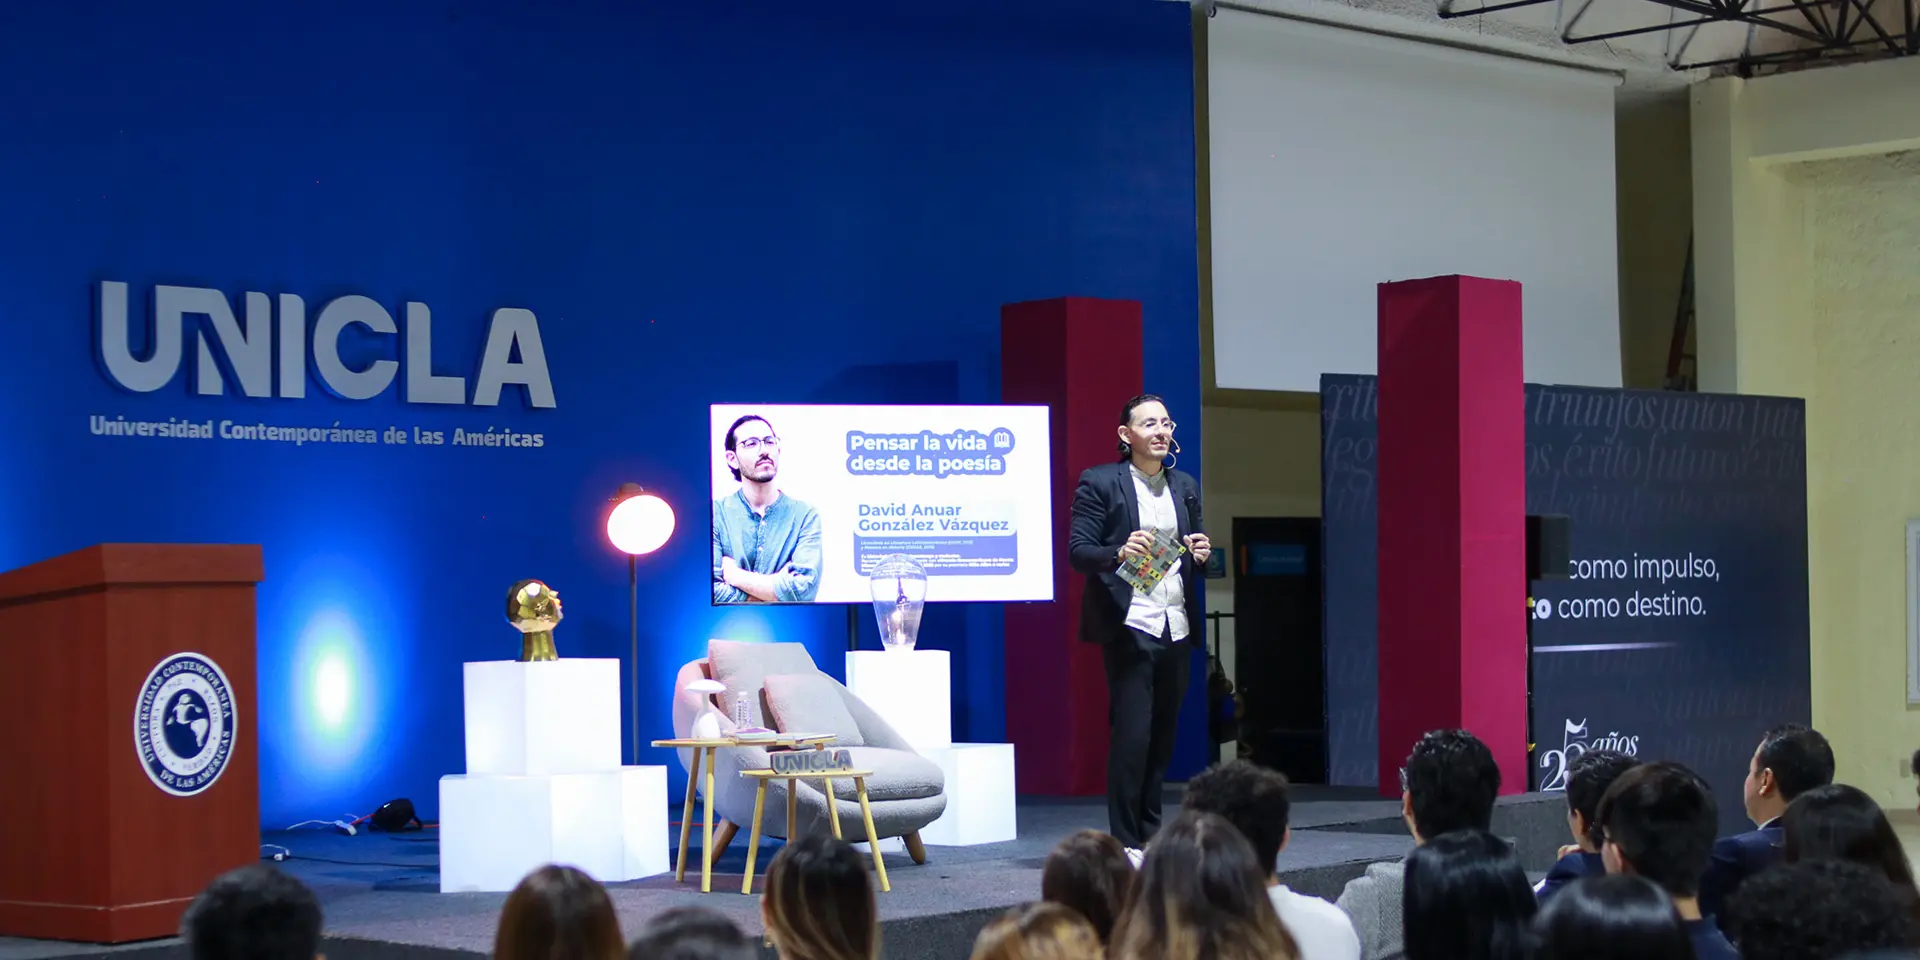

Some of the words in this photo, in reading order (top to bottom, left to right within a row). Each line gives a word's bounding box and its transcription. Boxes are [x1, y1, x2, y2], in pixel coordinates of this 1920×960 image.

[101, 280, 557, 409] UNICLA
[90, 414, 212, 439] Universidad
[219, 418, 378, 446] Contemporánea
[383, 425, 408, 445] de
[414, 425, 444, 446] las
[452, 425, 544, 448] Américas
[851, 435, 918, 451] Pensar
[924, 434, 941, 452] la
[946, 433, 987, 452] vida
[851, 455, 910, 471] desde
[915, 454, 933, 471] la
[939, 454, 1001, 474] poesía
[859, 504, 906, 516] David
[911, 504, 961, 516] Anuar
[859, 517, 934, 532] González
[940, 517, 1009, 534] Vázquez
[1633, 552, 1720, 584] impulso,
[1558, 598, 1620, 619] como
[1626, 590, 1707, 619] destino.
[140, 675, 164, 763] UNIVERSIDAD
[774, 750, 853, 773] UNICLA
[160, 770, 176, 785] DE
[176, 777, 195, 788] LAS
